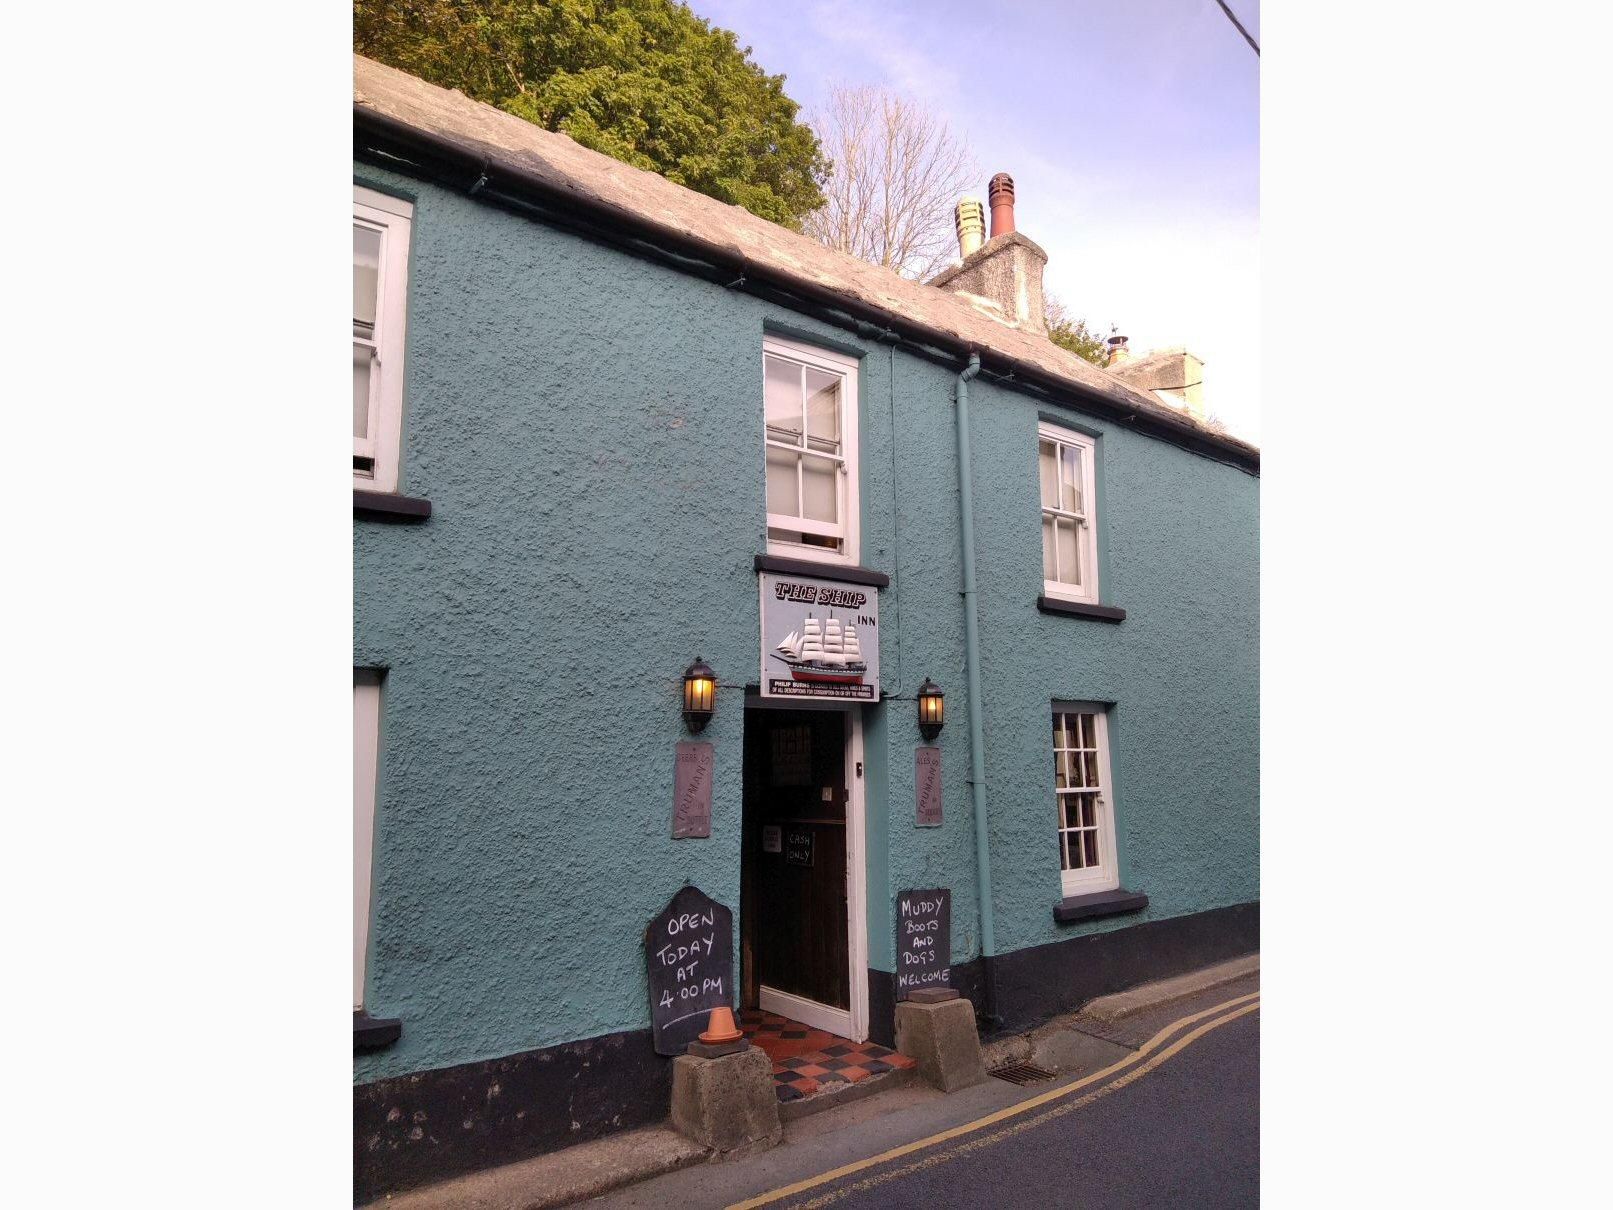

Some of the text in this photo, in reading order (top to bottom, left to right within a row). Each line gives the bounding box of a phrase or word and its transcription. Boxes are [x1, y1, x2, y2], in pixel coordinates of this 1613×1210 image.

[775, 582, 866, 609] THE SHIP
[857, 615, 876, 627] INN
[789, 833, 810, 846] CASH
[789, 850, 810, 862] ONLY
[901, 896, 944, 917] MUDDY
[667, 907, 714, 936] OPEN
[904, 919, 939, 934] BOOTS
[656, 932, 714, 966] TODAY
[912, 936, 934, 948] AND
[902, 949, 935, 965] DOGS
[676, 960, 699, 982] AT
[899, 968, 951, 987] WELCOME
[702, 976, 723, 995] PM
